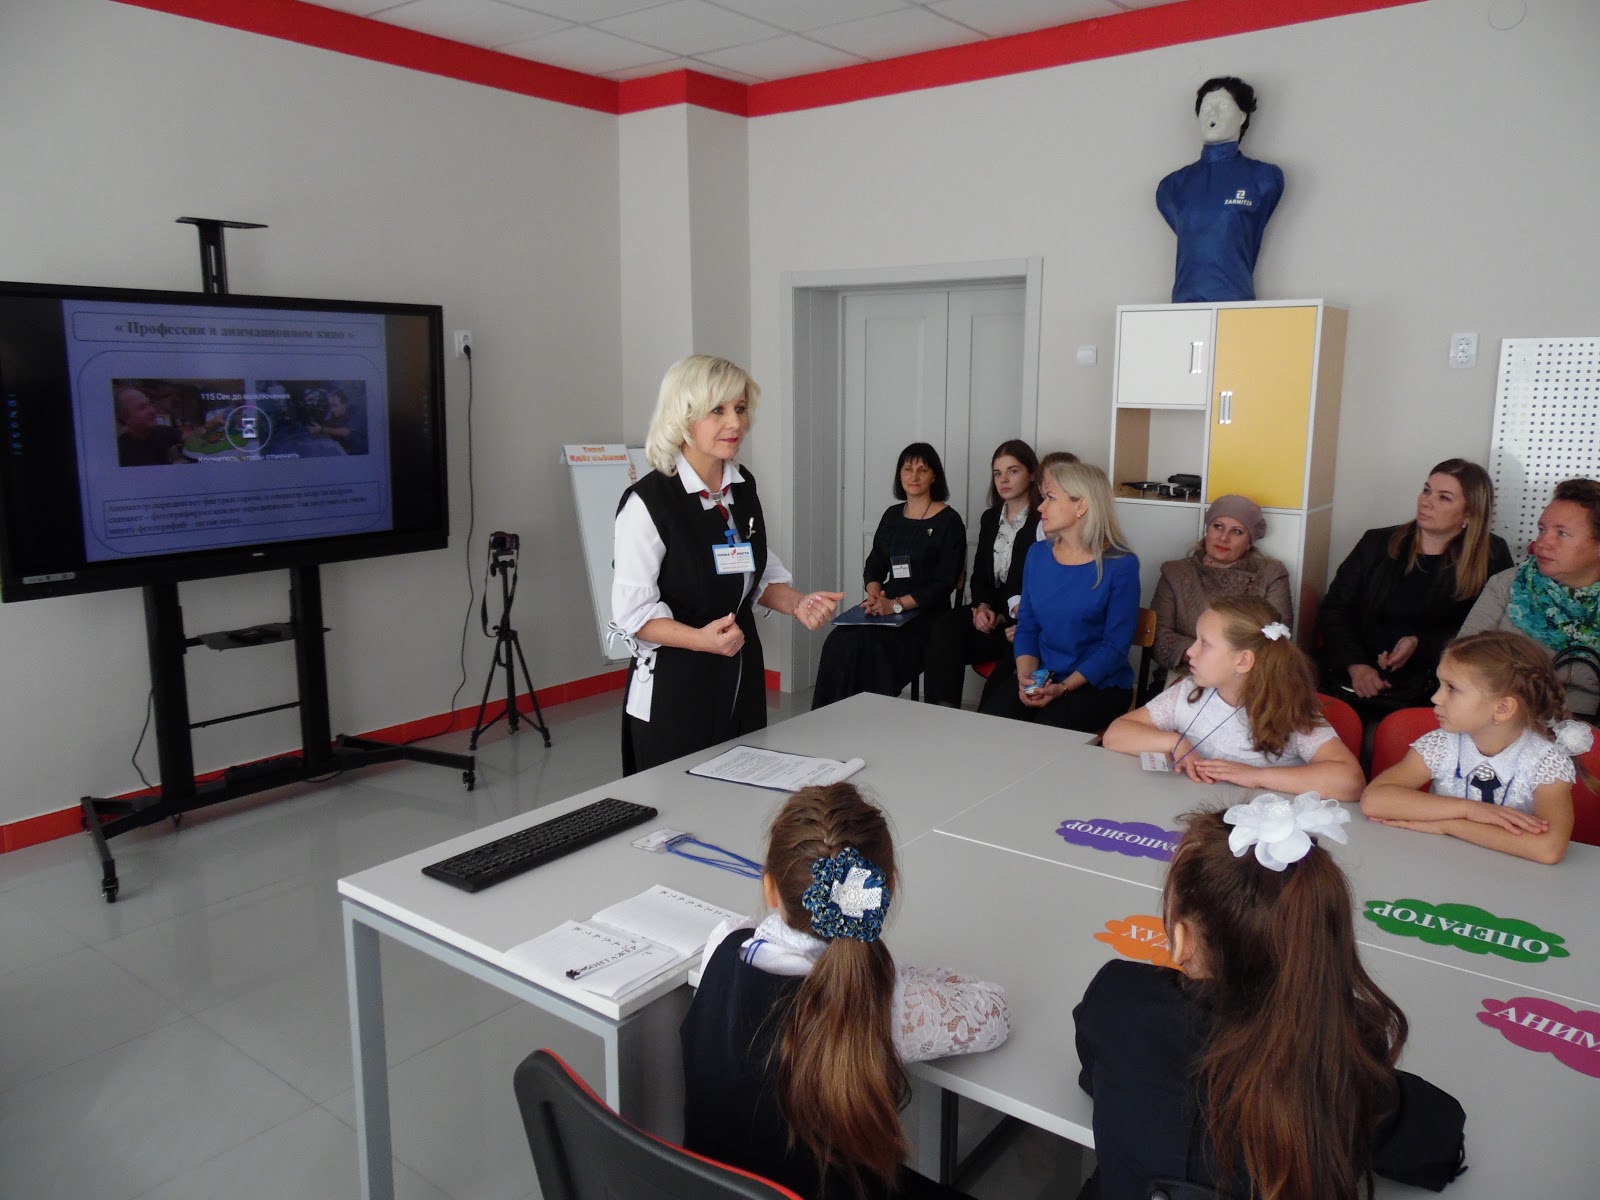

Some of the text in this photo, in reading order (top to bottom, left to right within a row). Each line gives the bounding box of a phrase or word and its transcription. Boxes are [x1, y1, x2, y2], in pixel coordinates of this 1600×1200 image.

[200, 393, 215, 401] 115
[216, 393, 231, 401] Сек
[231, 394, 242, 402] до
[1372, 903, 1550, 955] ОПЕРАТОР
